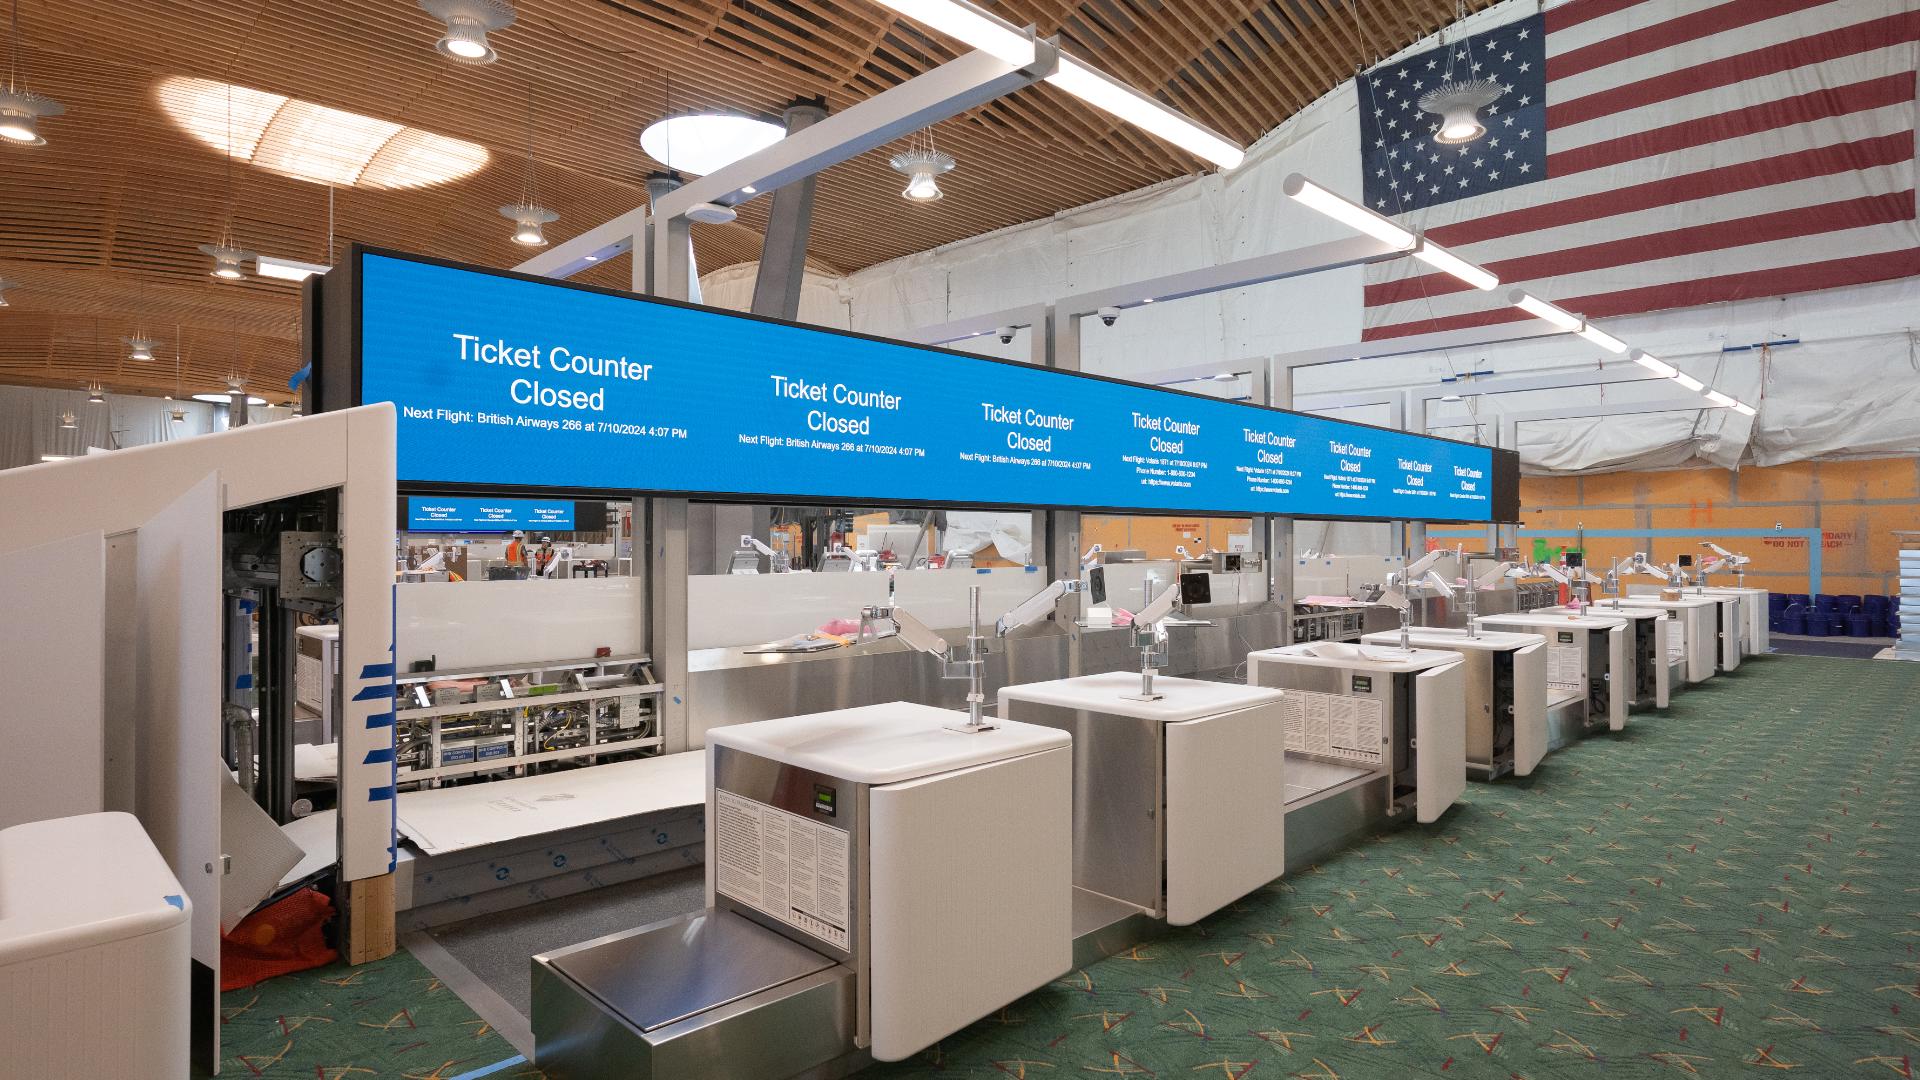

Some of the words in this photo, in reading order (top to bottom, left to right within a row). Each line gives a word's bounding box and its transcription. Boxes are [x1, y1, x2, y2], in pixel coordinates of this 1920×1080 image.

[453, 334, 540, 368] Ticket
[550, 347, 652, 380] Counter
[511, 379, 603, 410] Closed
[771, 375, 827, 402] Ticket
[833, 384, 901, 410] Counter
[404, 407, 433, 419] Next
[437, 409, 473, 423] Flight:
[478, 413, 513, 425] British
[516, 416, 559, 430] Airways
[562, 420, 582, 430] 266
[585, 422, 594, 432] at
[598, 423, 646, 435] 7/10/2024
[649, 427, 669, 436] 4:07
[672, 429, 687, 438] PM
[808, 410, 869, 435] Closed
[982, 403, 1021, 424] Ticket
[1025, 409, 1073, 430] Counter
[1132, 412, 1161, 430] Ticket
[1164, 417, 1200, 435] Counter
[739, 434, 758, 444] Next
[760, 436, 783, 447] Flight:
[786, 438, 809, 447] British
[811, 440, 839, 451] Airways
[841, 442, 854, 451] 266
[856, 444, 863, 452] at
[865, 444, 897, 454] 7/10/2024
[899, 447, 912, 456] 4:07
[915, 449, 925, 457] PM
[1008, 432, 1050, 452] Closed
[1151, 437, 1183, 454] Closed
[1243, 429, 1266, 444] Ticket
[1268, 432, 1296, 447] Counter
[1258, 449, 1282, 464] Closed
[1329, 441, 1347, 455] Ticket
[1348, 444, 1371, 458] Counter
[960, 452, 973, 461] Next
[975, 454, 991, 463] Flight:
[993, 455, 1009, 463] British
[1010, 457, 1030, 466] Airways
[1082, 462, 1091, 470] PM
[1340, 460, 1361, 473] Closed
[1398, 458, 1413, 470] Ticket
[1413, 461, 1432, 473] Counter
[1407, 475, 1423, 487] Closed
[1454, 466, 1466, 477] Ticket
[1467, 468, 1482, 479] Counter
[1461, 480, 1475, 491] Closed
[1787, 540, 1805, 548] NOT
